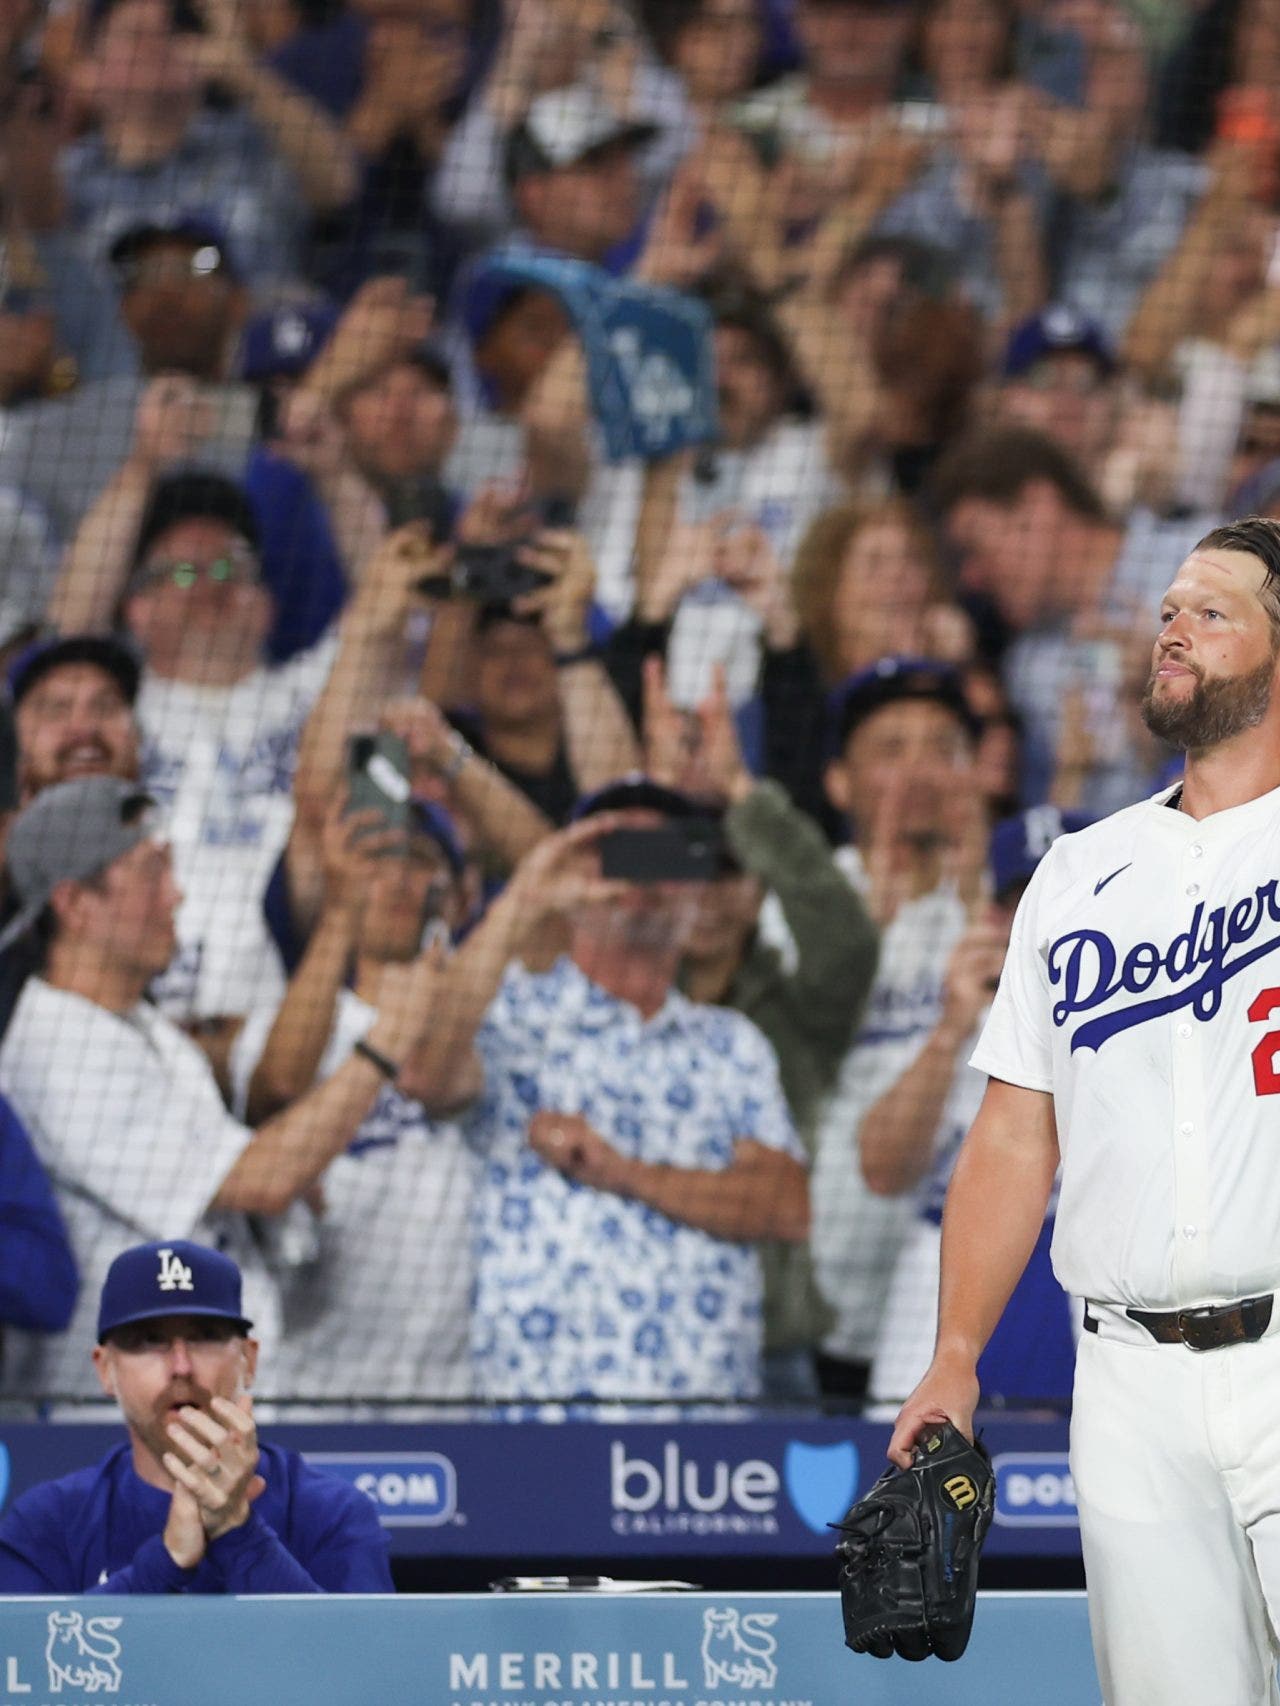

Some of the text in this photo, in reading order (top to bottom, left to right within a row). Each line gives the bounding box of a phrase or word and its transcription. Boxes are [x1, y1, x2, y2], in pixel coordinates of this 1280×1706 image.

[156, 1248, 195, 1291] LA
[611, 1440, 781, 1513] blue
[449, 1652, 689, 1690] MERRILL
